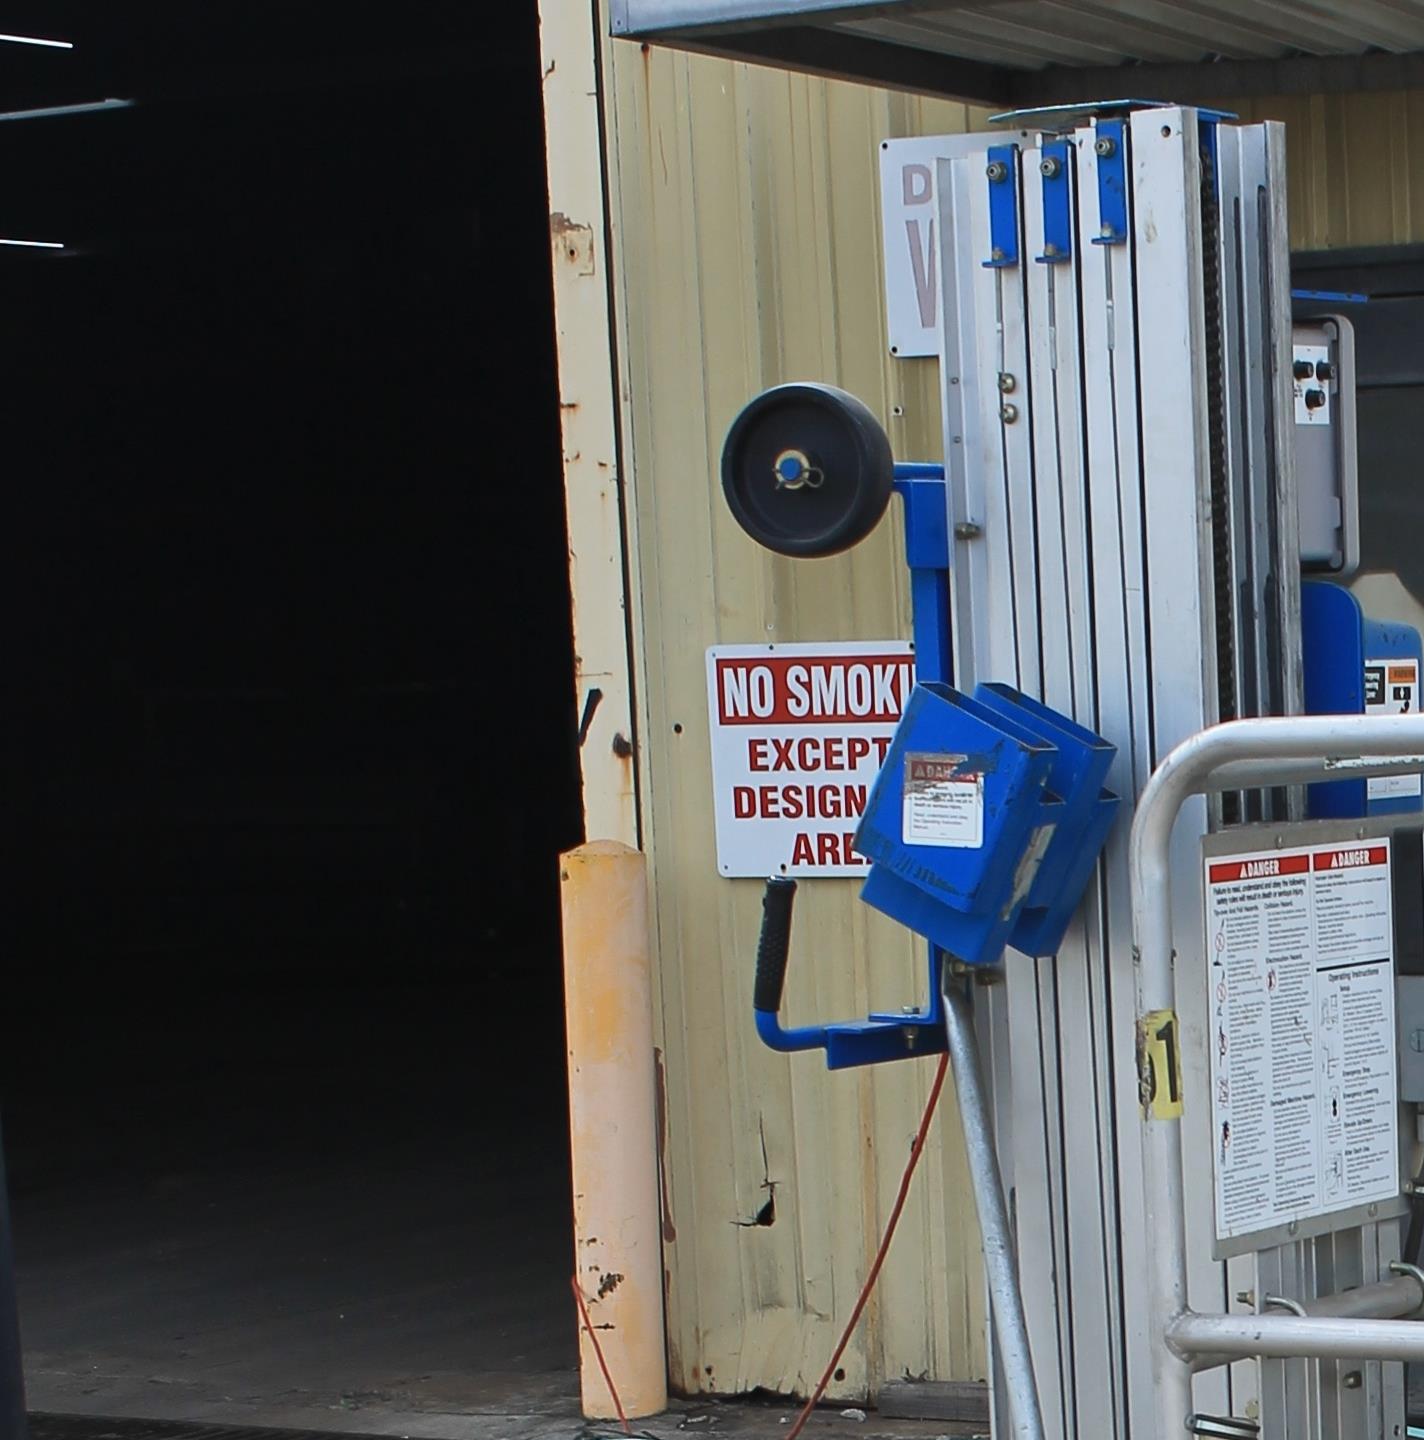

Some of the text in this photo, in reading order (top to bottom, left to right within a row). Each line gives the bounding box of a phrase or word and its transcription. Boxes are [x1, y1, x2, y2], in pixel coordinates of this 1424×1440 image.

[722, 664, 774, 718] NO
[748, 737, 893, 772] EXCEPT
[733, 784, 867, 819] DESIGN
[791, 832, 873, 866] ARE
[1338, 849, 1370, 867] DANGER
[1247, 860, 1281, 878] DANGER
